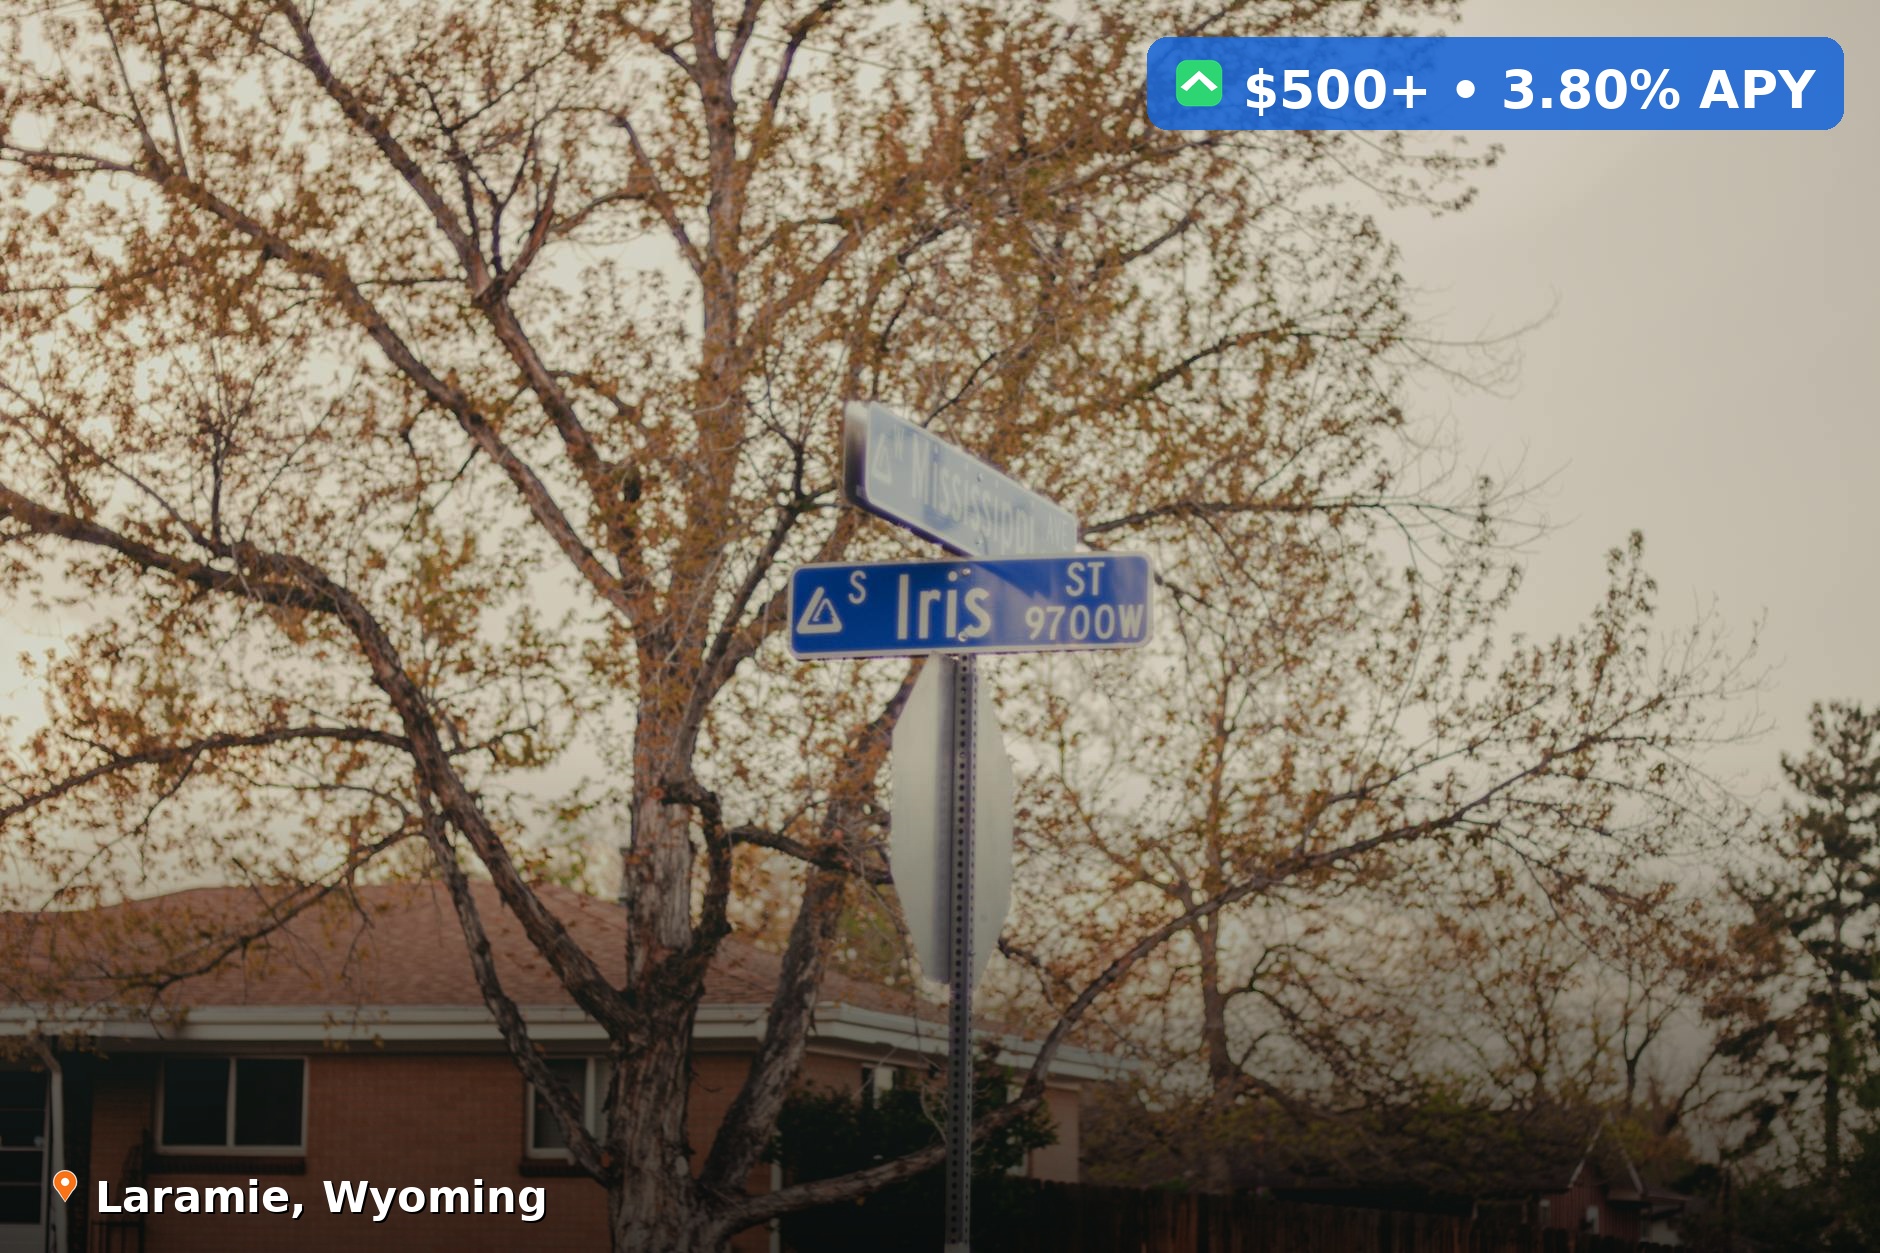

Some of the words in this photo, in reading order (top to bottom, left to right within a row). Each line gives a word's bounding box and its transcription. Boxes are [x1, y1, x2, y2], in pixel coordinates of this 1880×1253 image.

[848, 570, 867, 604] S
[897, 571, 992, 640] Iris
[1065, 561, 1105, 597] ST
[1025, 604, 1144, 640] 9700W
